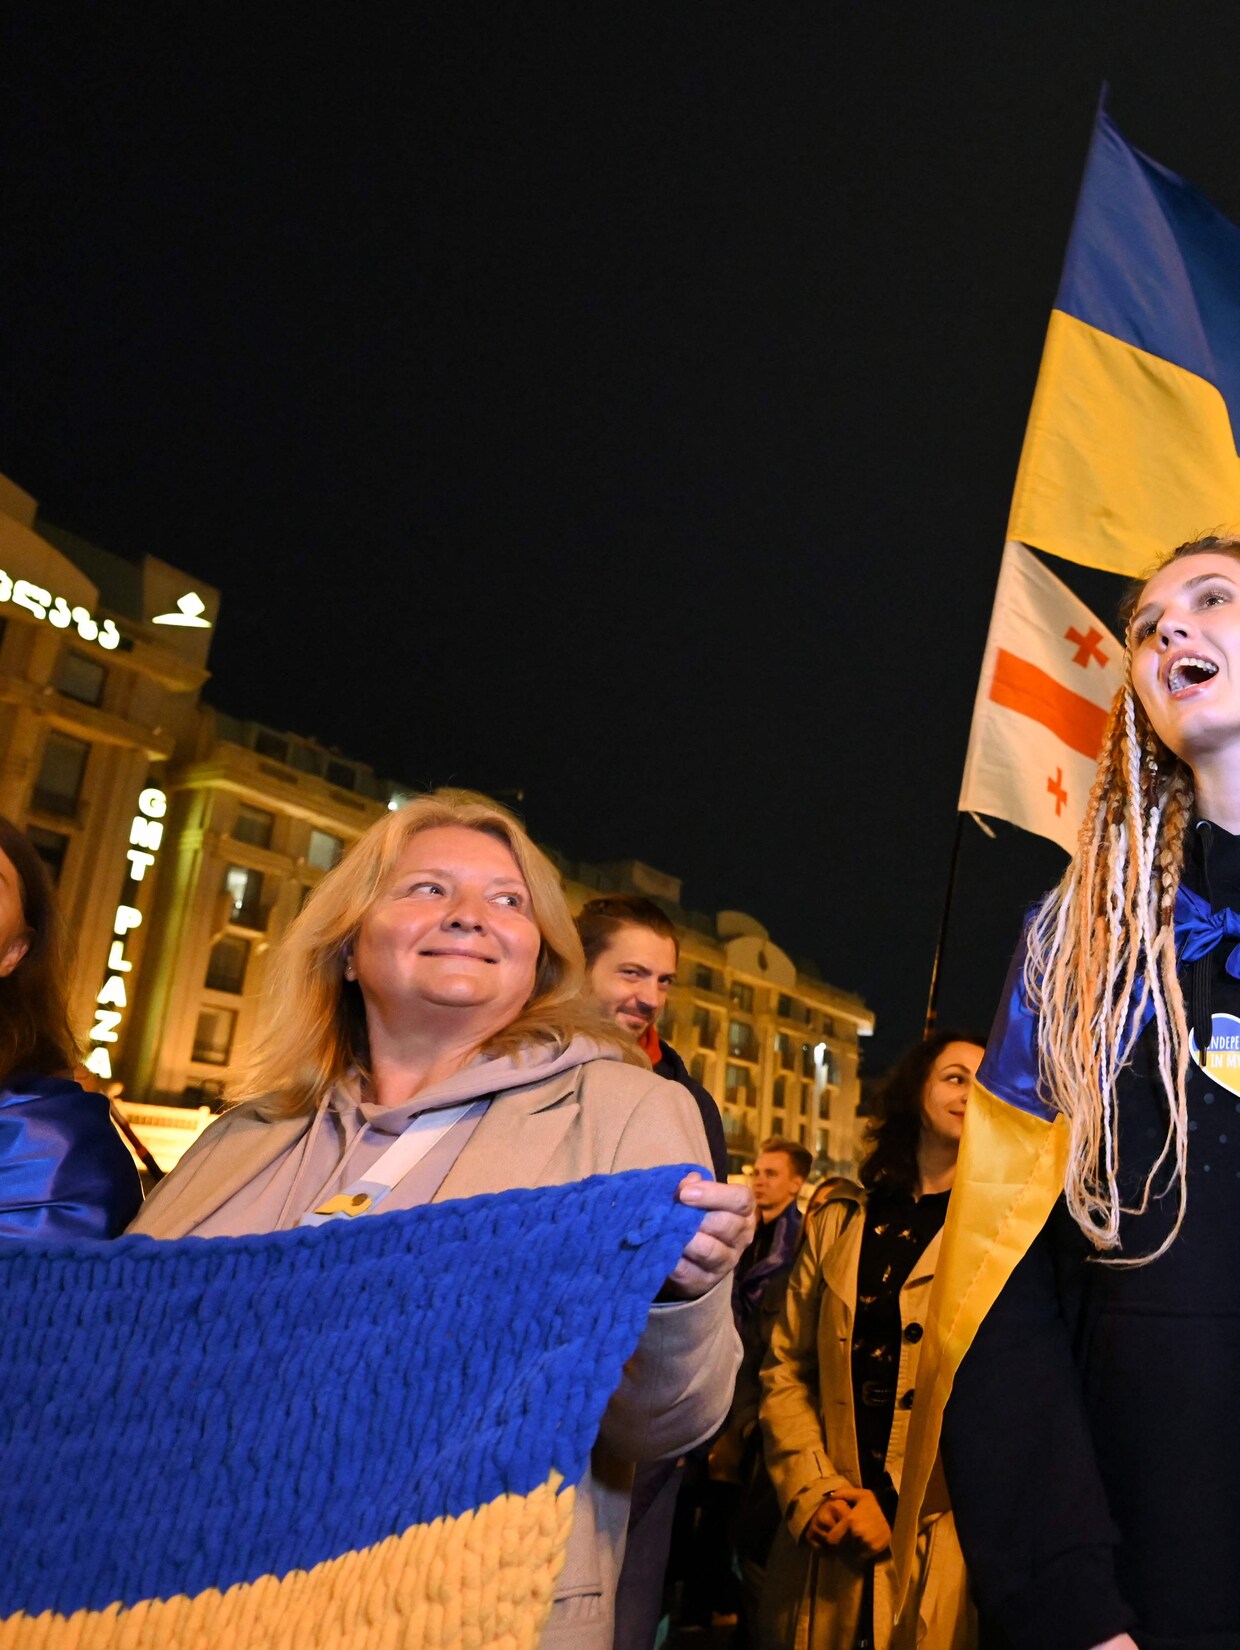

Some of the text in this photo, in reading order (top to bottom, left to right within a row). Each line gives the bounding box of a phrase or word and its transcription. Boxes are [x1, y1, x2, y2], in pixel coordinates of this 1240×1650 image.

[84, 788, 167, 1079] GMT PLAZA
[1210, 1053, 1223, 1068] IN
